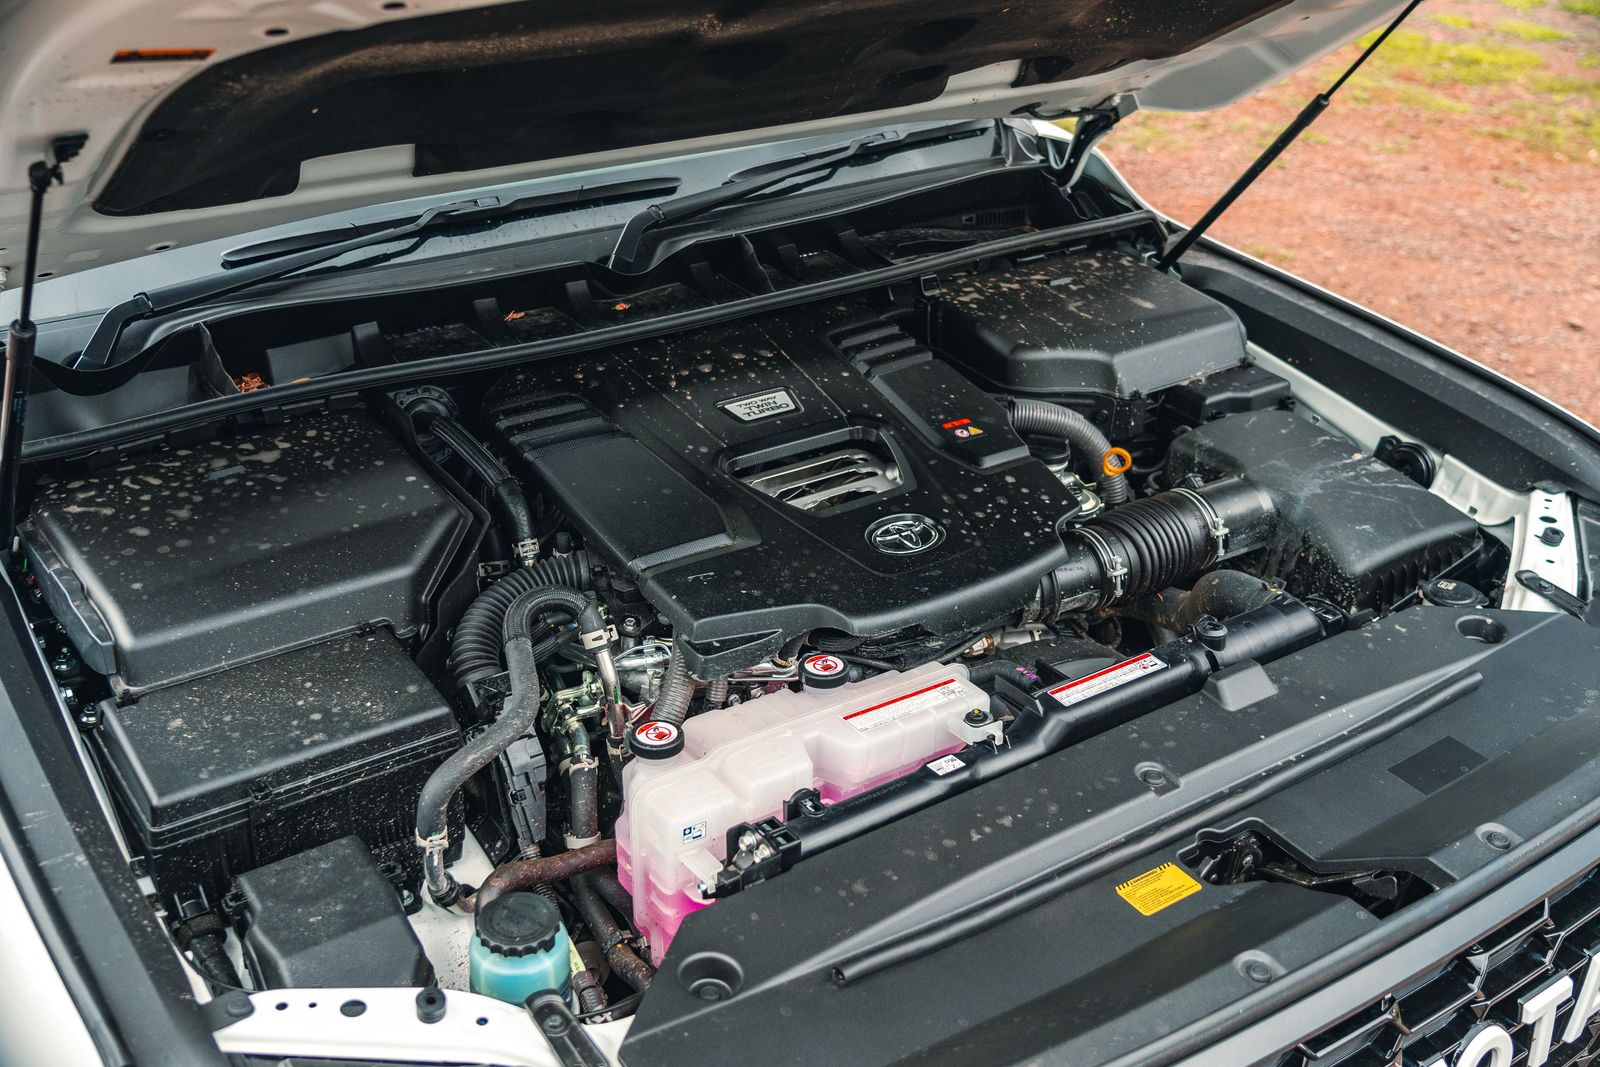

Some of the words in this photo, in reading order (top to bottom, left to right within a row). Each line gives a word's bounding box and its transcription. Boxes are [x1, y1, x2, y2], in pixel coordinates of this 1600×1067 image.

[736, 400, 758, 409] TWO
[742, 403, 790, 417] TURBO
[743, 400, 778, 411] TWIN
